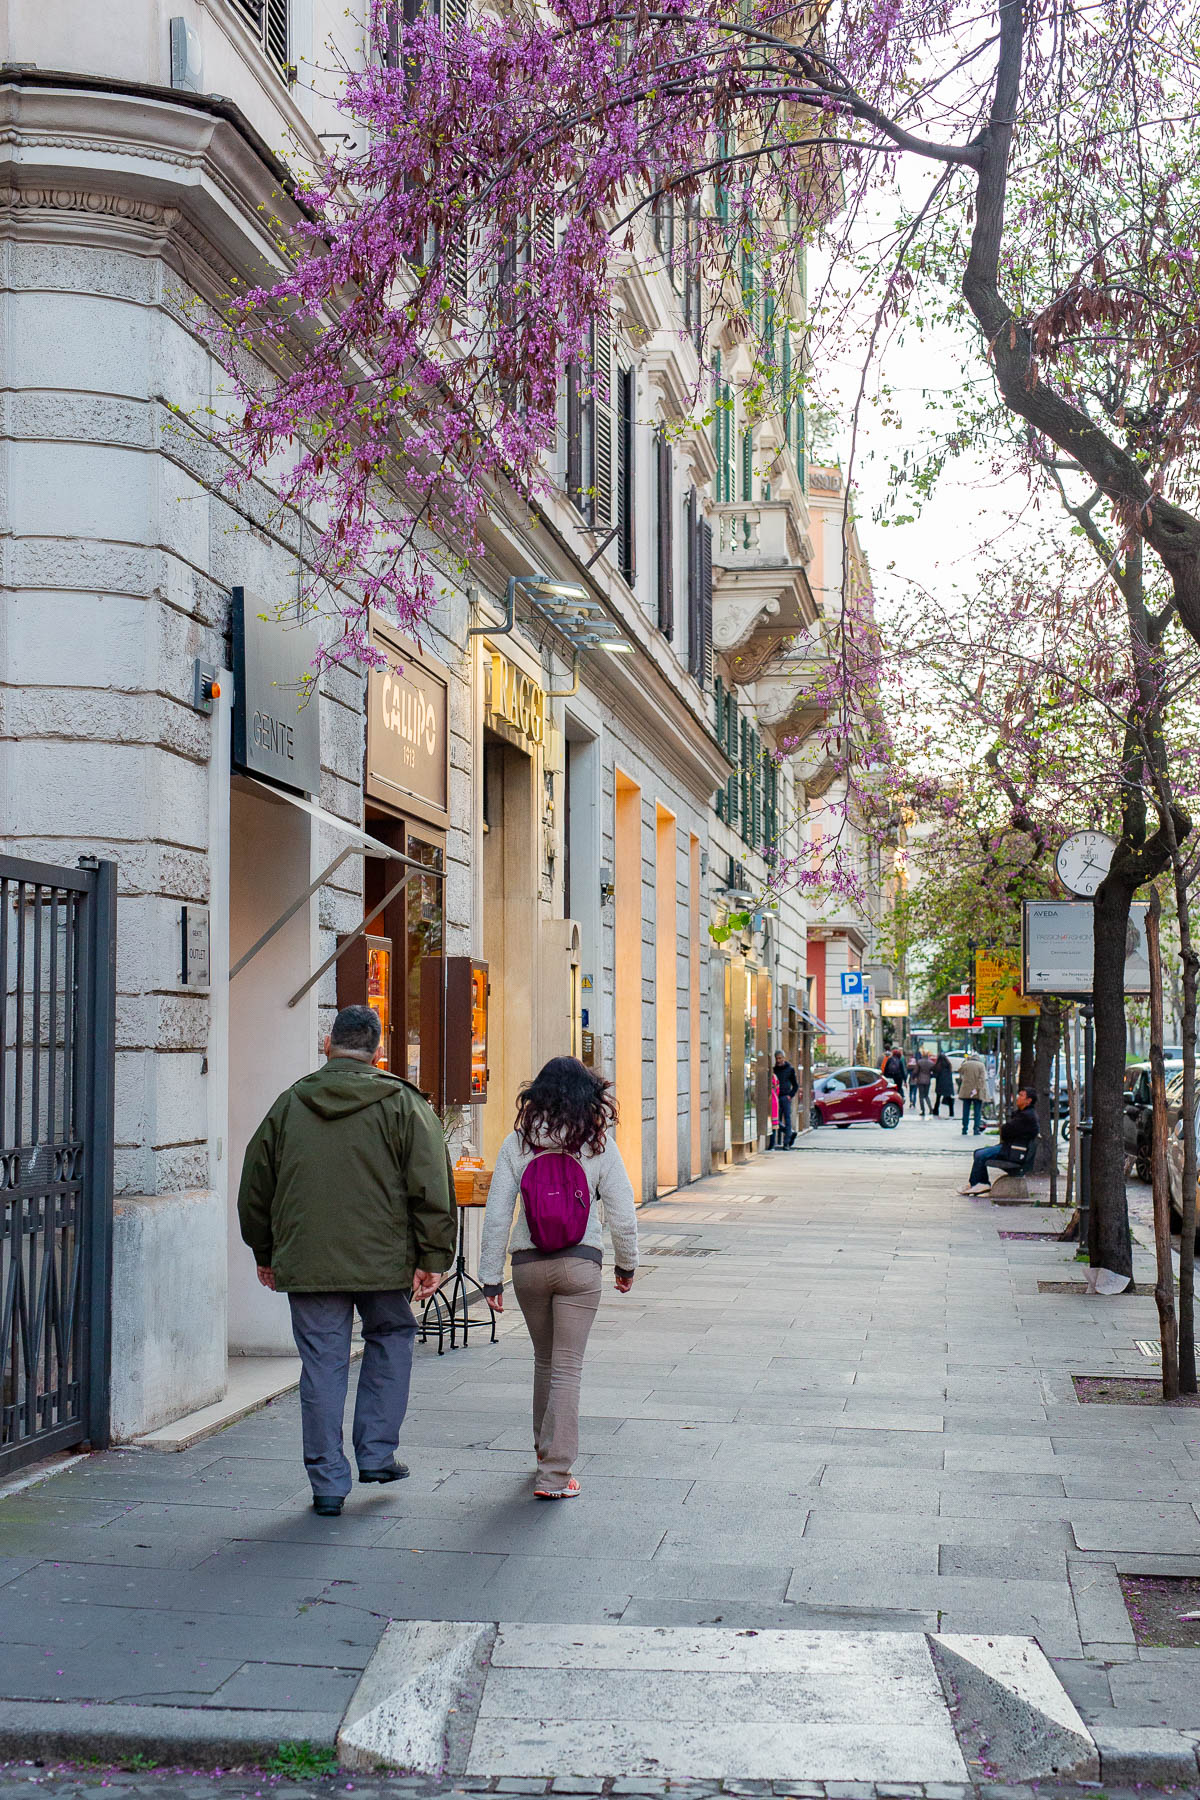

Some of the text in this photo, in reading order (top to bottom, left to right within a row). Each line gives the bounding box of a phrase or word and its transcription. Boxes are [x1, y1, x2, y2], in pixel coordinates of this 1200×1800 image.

[382, 675, 436, 756] CALLIPO
[253, 710, 294, 760] GENTE
[1084, 835, 1096, 846] 12
[1060, 859, 1067, 869] 9
[1085, 883, 1093, 893] 6
[189, 948, 206, 960] OUTLET
[844, 974, 859, 993] P
